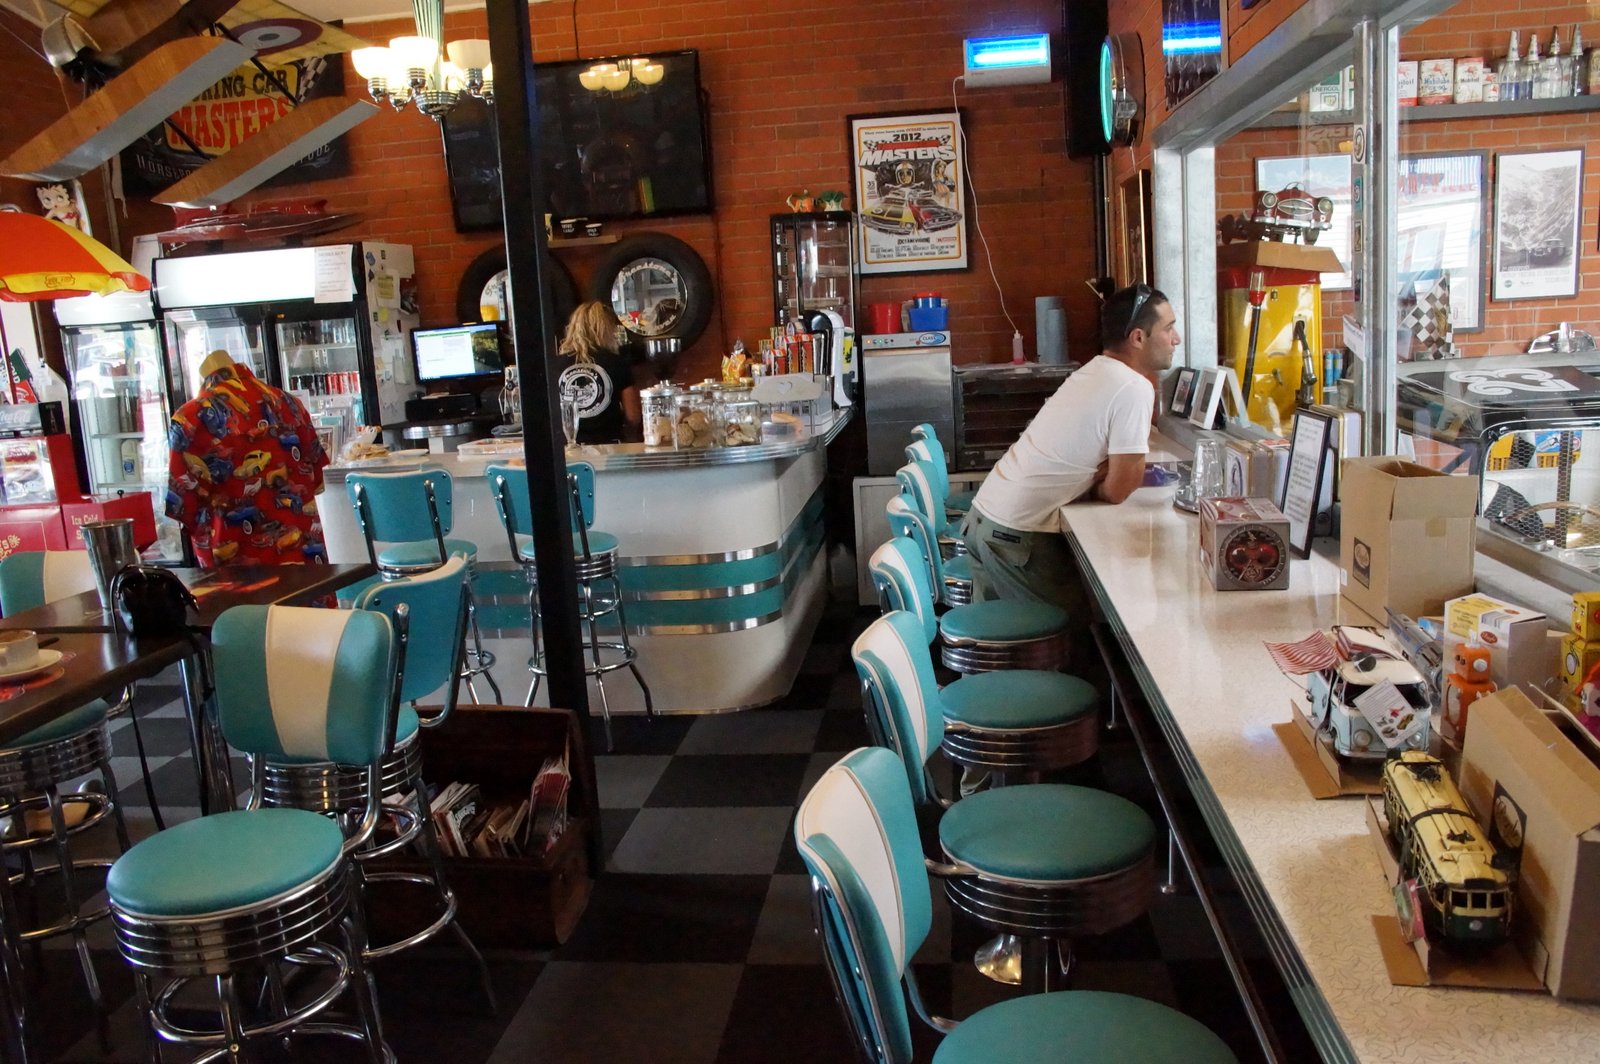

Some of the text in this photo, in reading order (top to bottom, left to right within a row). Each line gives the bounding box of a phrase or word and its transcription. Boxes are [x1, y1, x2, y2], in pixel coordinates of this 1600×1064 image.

[252, 69, 289, 95] CAR
[892, 132, 922, 142] 2012
[859, 145, 957, 166] MASTERS
[71, 513, 99, 526] Ice Cold
